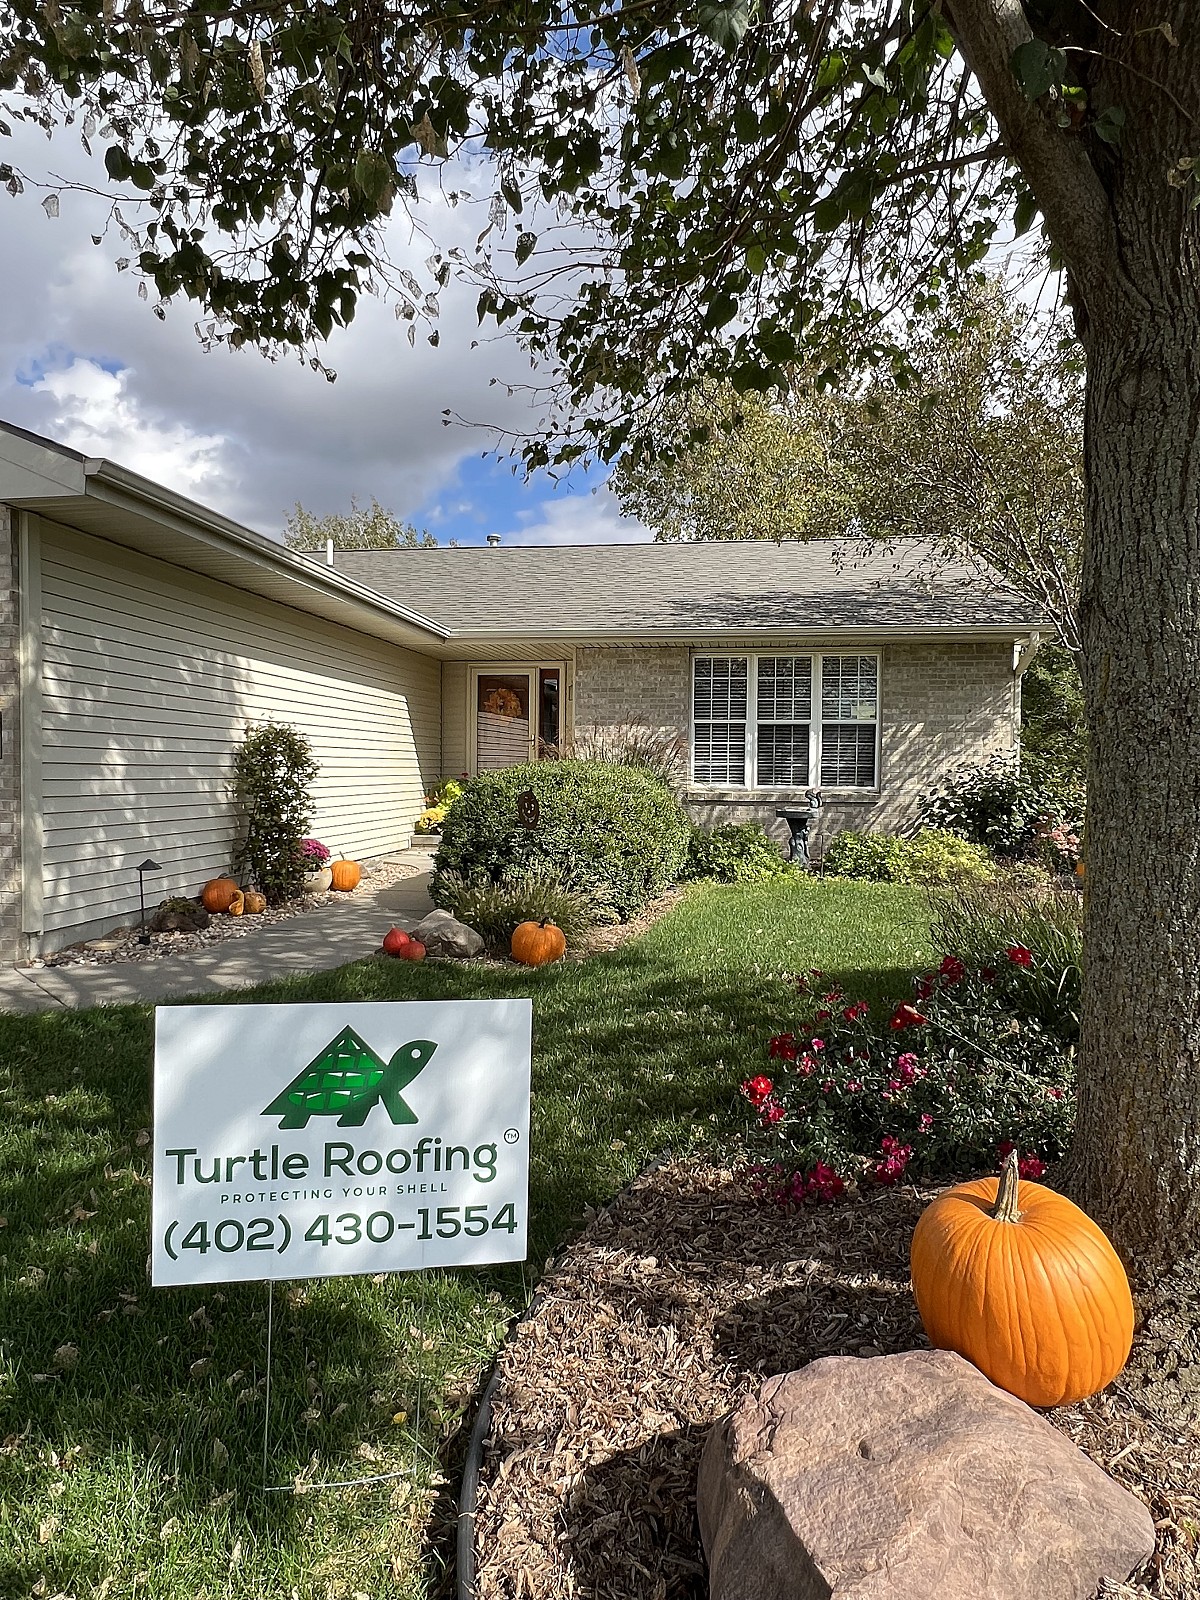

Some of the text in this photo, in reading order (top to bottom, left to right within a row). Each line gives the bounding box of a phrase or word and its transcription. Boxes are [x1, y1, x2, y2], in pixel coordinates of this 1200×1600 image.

[165, 1144, 309, 1185] Turtle
[323, 1137, 498, 1183] Roofing
[220, 1182, 448, 1204] PROTECTING YOUR SHELL
[164, 1202, 518, 1261] (402) 430-1554
